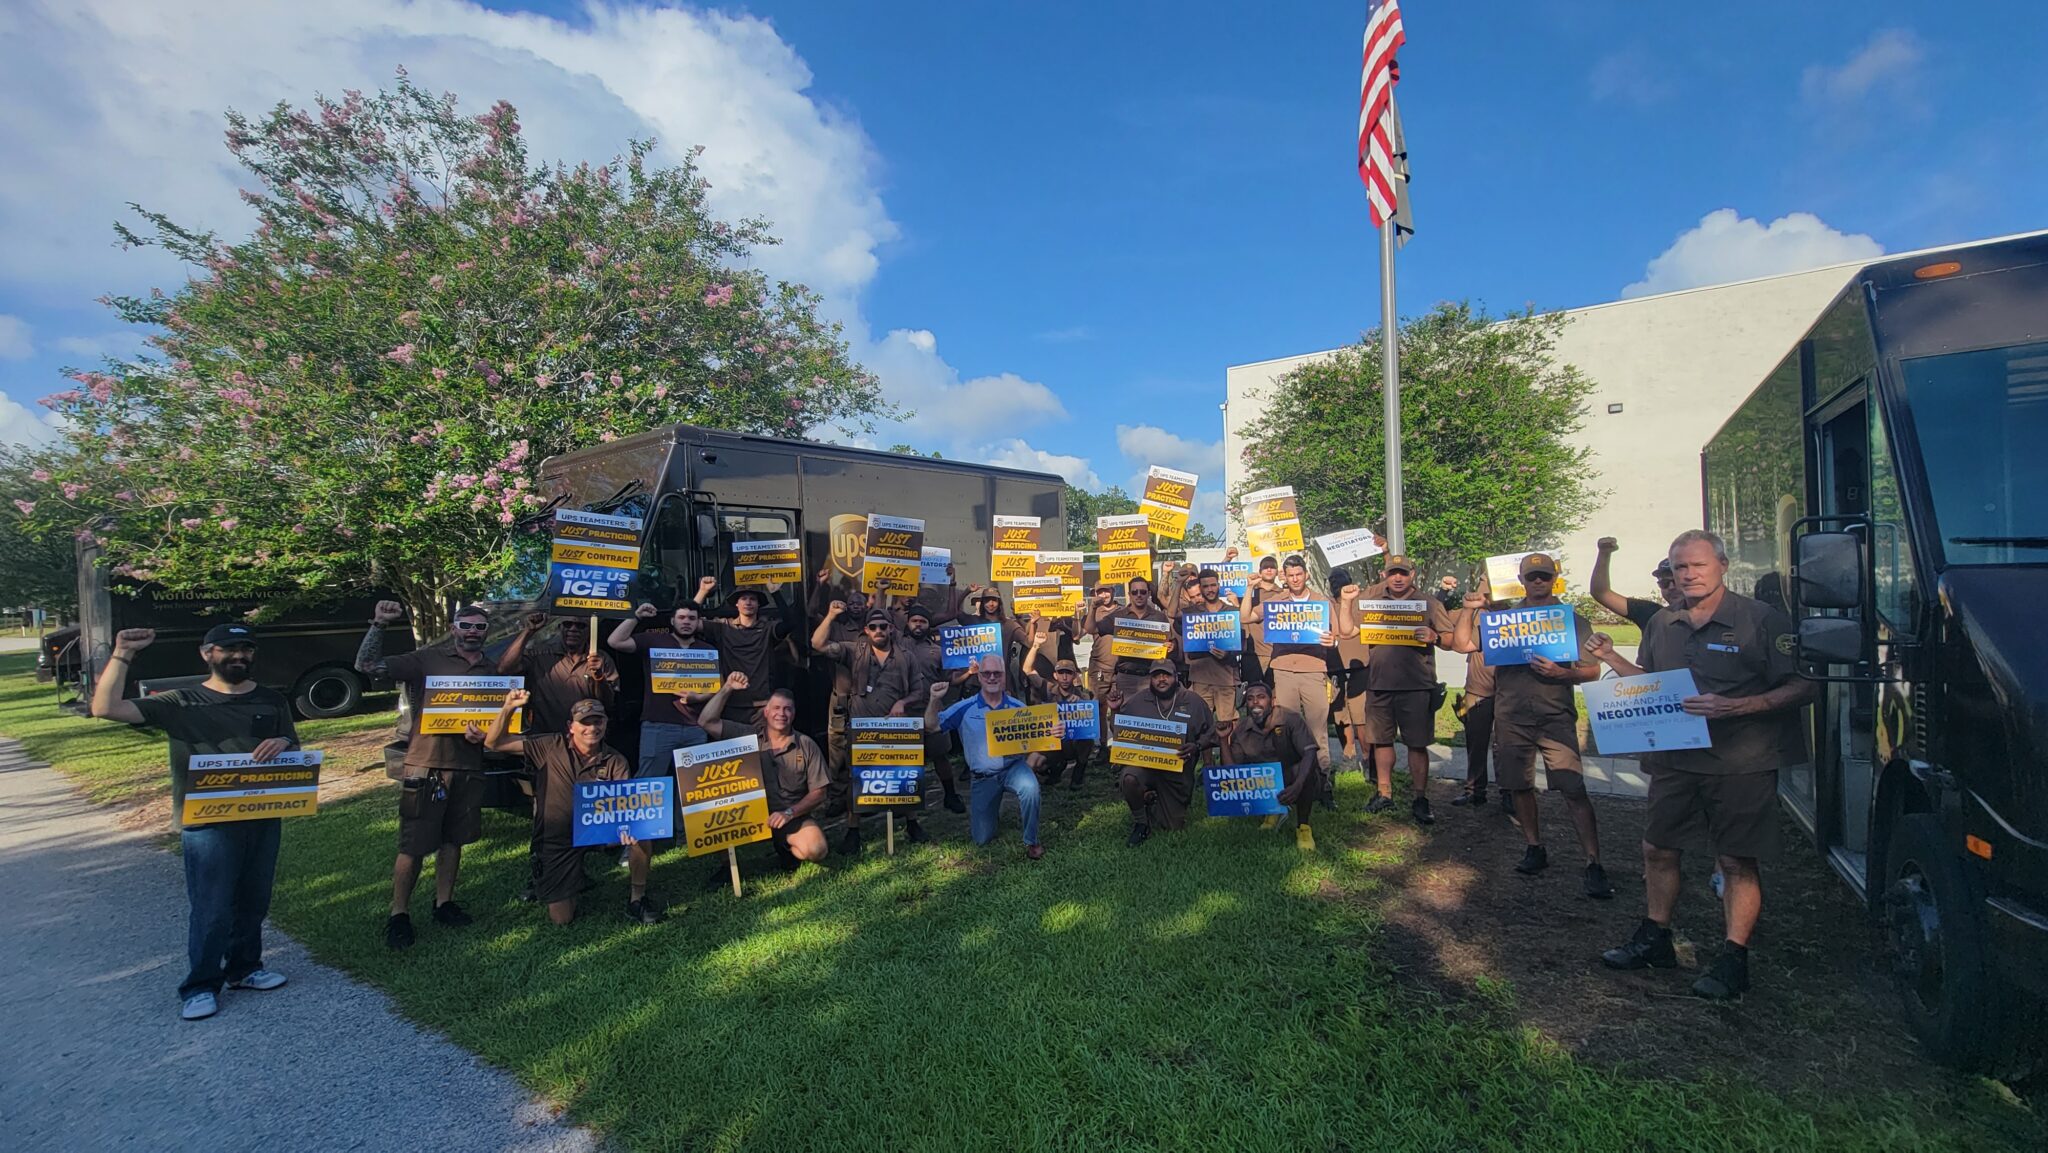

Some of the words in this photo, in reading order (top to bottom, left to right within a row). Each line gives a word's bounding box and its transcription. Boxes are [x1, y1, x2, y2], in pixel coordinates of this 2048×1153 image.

[1156, 481, 1184, 494] JUST
[1146, 492, 1188, 507] PRACTICING
[580, 516, 628, 526] TEAMSTERS:
[1149, 509, 1176, 521] JUST
[561, 526, 588, 535] JUST
[589, 530, 637, 541] PRACTICING
[880, 532, 912, 544] JUST
[1003, 529, 1030, 538] JUST
[1109, 528, 1137, 540] JUST
[833, 534, 866, 567] ups
[870, 547, 918, 558] PRACTICING
[1102, 542, 1147, 551] PRACTICING
[559, 549, 586, 558] JUST
[587, 552, 634, 563] CONTRACT
[1002, 558, 1029, 566] JUST
[1046, 565, 1073, 574] JUST
[1111, 558, 1139, 568] JUST
[561, 569, 604, 579] GIVE
[606, 572, 631, 582] US
[876, 566, 908, 577] JUST
[1105, 571, 1147, 579] CONTRACT
[562, 580, 610, 596] ICE
[1268, 604, 1324, 612] UNITED
[1186, 614, 1235, 623] UNITED
[1276, 611, 1323, 623] STRONG
[1486, 609, 1565, 626] UNITED
[944, 626, 996, 638] UNITED
[1194, 620, 1234, 633] STRONG
[1269, 621, 1324, 630] CONTRACT
[1499, 618, 1565, 640] STRONG
[953, 633, 996, 649] STRONG
[1187, 631, 1236, 640] CONTRACT
[1489, 632, 1567, 649] CONTRACT
[946, 643, 997, 656] CONTRACT
[1614, 678, 1664, 698] Support
[431, 693, 462, 702] JUST
[462, 694, 507, 702] PRACTICI
[1603, 694, 1680, 709] RANK-AND-FILE
[1013, 709, 1032, 717] Make
[1057, 702, 1094, 711] NITED
[1597, 702, 1684, 720] NEGOTIATOR
[1059, 710, 1093, 720] TRONG
[428, 719, 459, 727] JUST
[993, 721, 1053, 734] AMERICAN
[1065, 718, 1095, 727] TRACT
[1133, 721, 1173, 730] TEAMSTERS:
[857, 731, 879, 739] JUST
[995, 729, 1052, 742] WORKERS
[1118, 730, 1140, 738] JUST
[1140, 734, 1181, 744] PRACTICING
[712, 745, 754, 757] TEAMSTERS:
[1116, 751, 1137, 759] JUST
[1138, 755, 1178, 765] CONTRACT
[697, 759, 743, 782] JUST
[860, 770, 895, 779] GIVE
[898, 770, 918, 778] US
[1209, 767, 1275, 779] UNITED
[196, 773, 239, 786] JUST
[240, 771, 313, 782] PRACTICING
[1220, 776, 1275, 793] STRONG
[582, 781, 665, 798] UNITED
[686, 778, 759, 802] PRACTICING
[862, 780, 901, 794] ICE
[1212, 789, 1278, 800] CONTRACT
[194, 804, 236, 816] JUST
[237, 800, 308, 813] CONTRACT
[594, 790, 664, 815] STRONG
[582, 806, 664, 825] CONTRACT
[704, 805, 750, 828] JUST
[694, 823, 764, 848] CONTRACT
